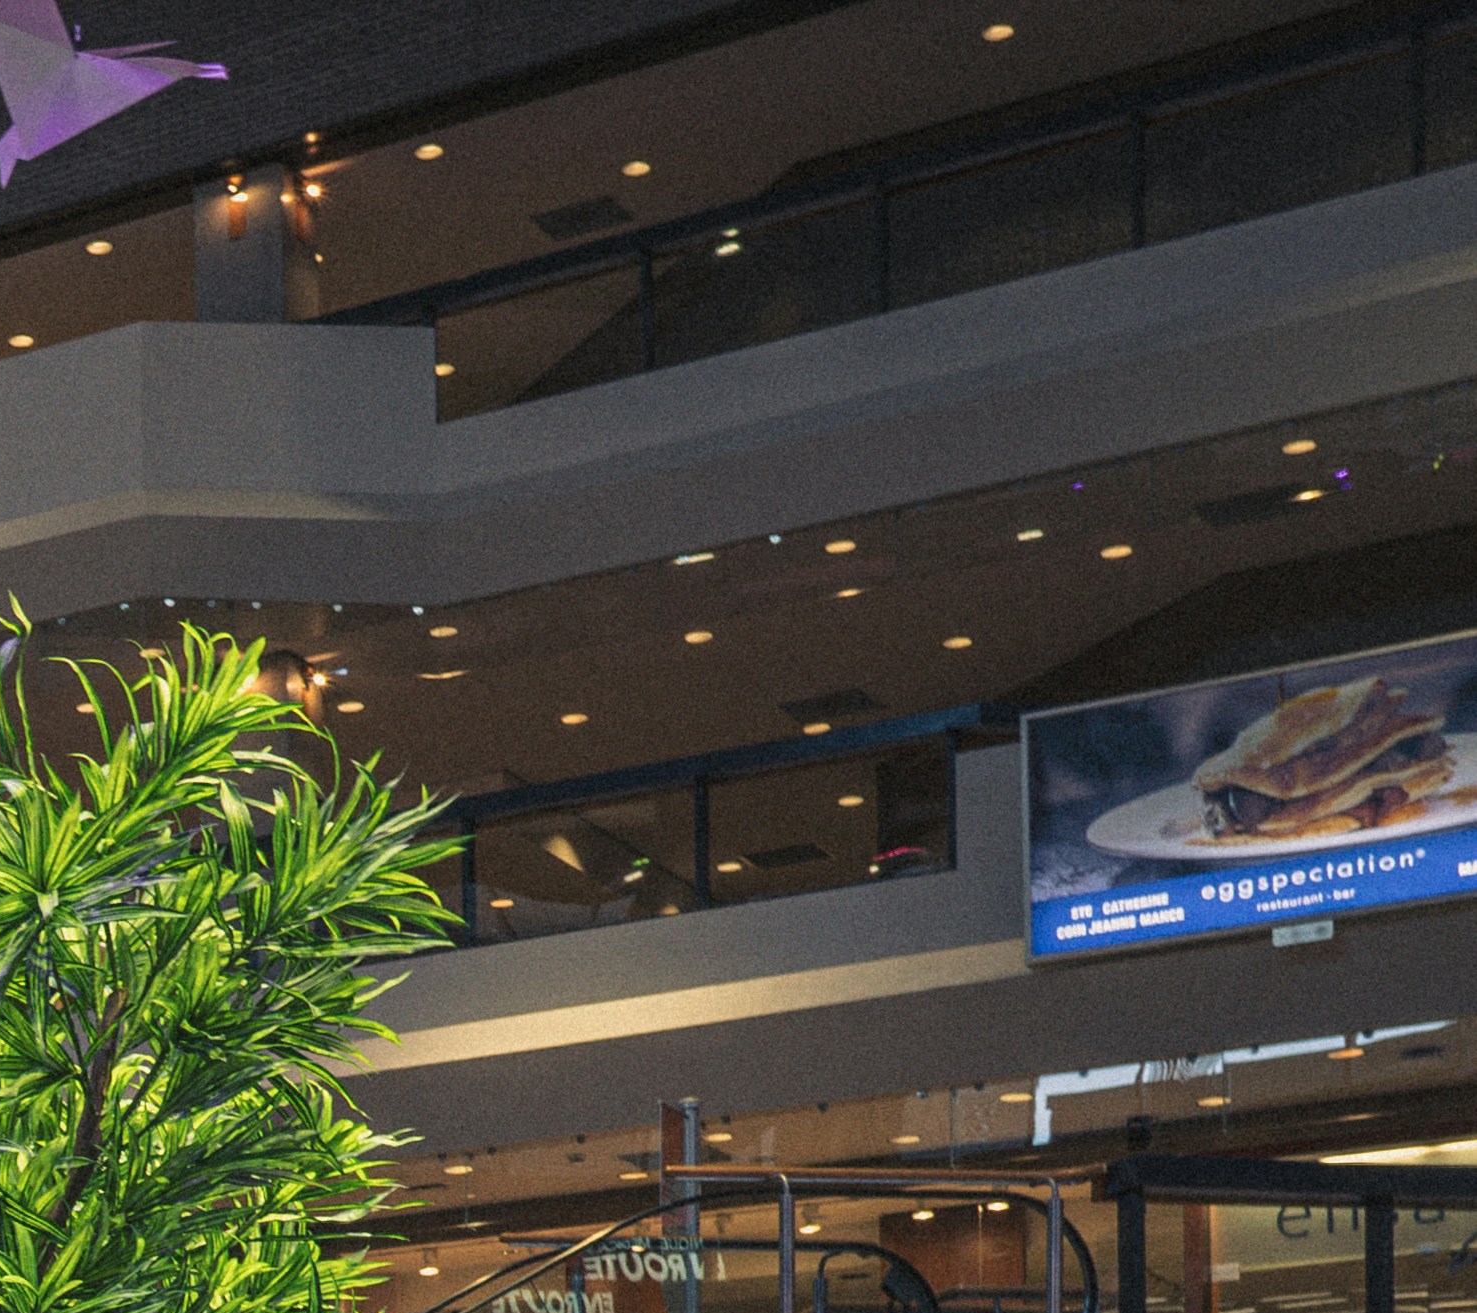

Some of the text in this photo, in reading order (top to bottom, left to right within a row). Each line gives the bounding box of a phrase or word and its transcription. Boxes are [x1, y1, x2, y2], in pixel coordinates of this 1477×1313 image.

[1201, 852, 1414, 903] eggspectation
[1102, 892, 1169, 915] CATHERINE
[1256, 887, 1356, 912] restaurant bar
[1056, 922, 1087, 940] COIN
[1088, 914, 1137, 936] JEANNE
